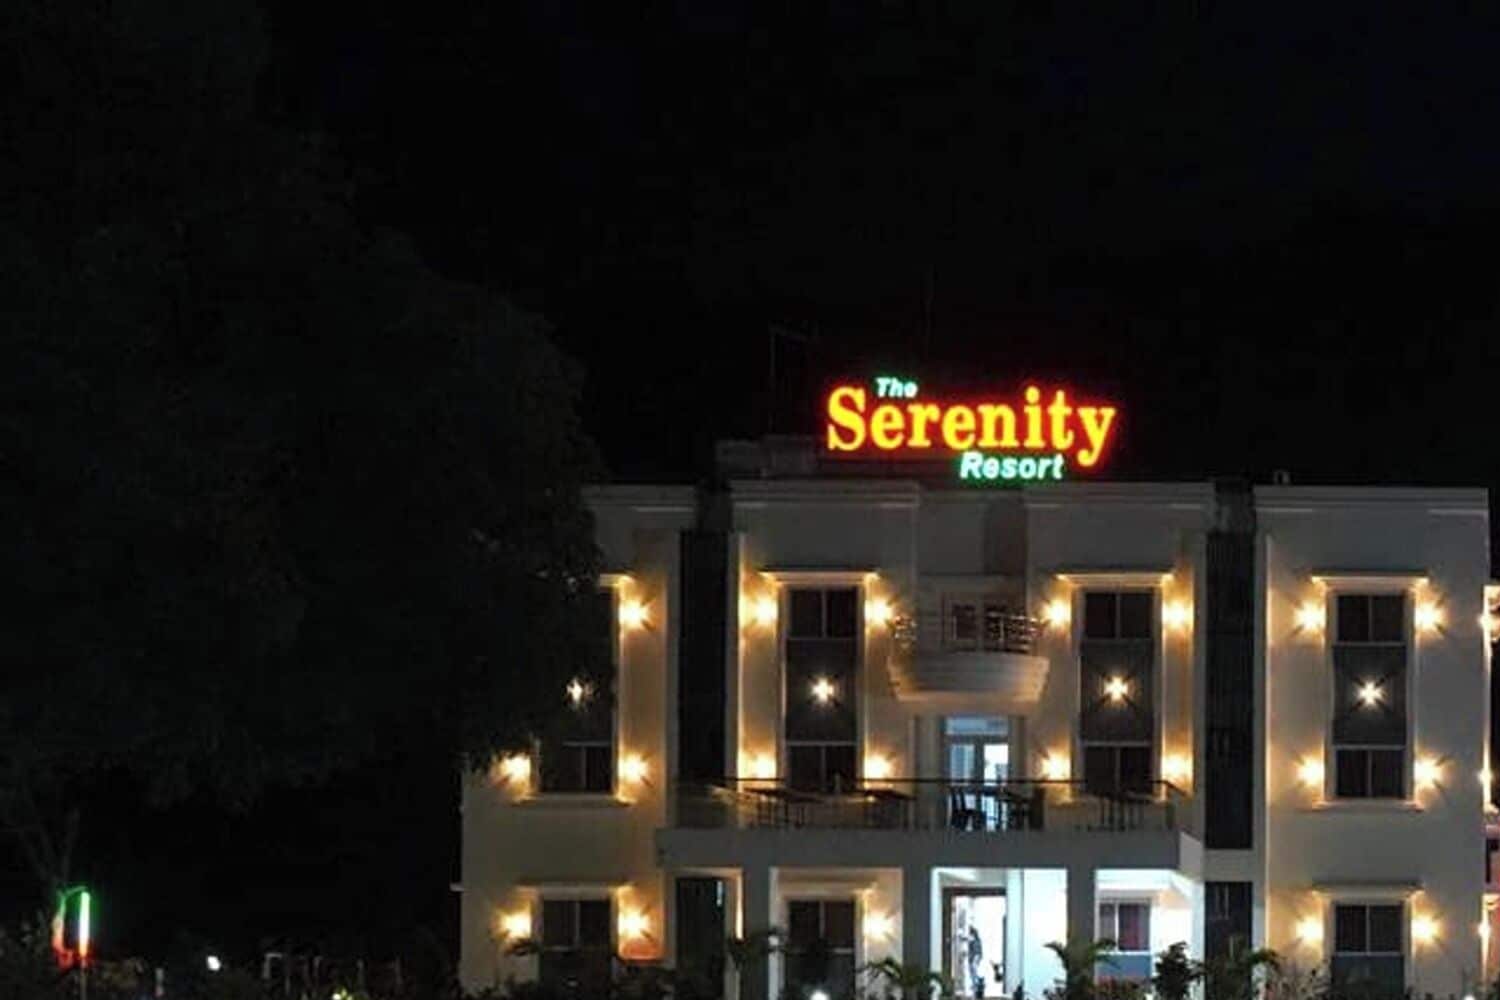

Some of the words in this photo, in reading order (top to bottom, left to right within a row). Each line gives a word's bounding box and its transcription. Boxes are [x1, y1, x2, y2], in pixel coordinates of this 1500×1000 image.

[875, 377, 918, 397] The
[827, 385, 1116, 466] Serenity
[959, 451, 1065, 479] Resort
